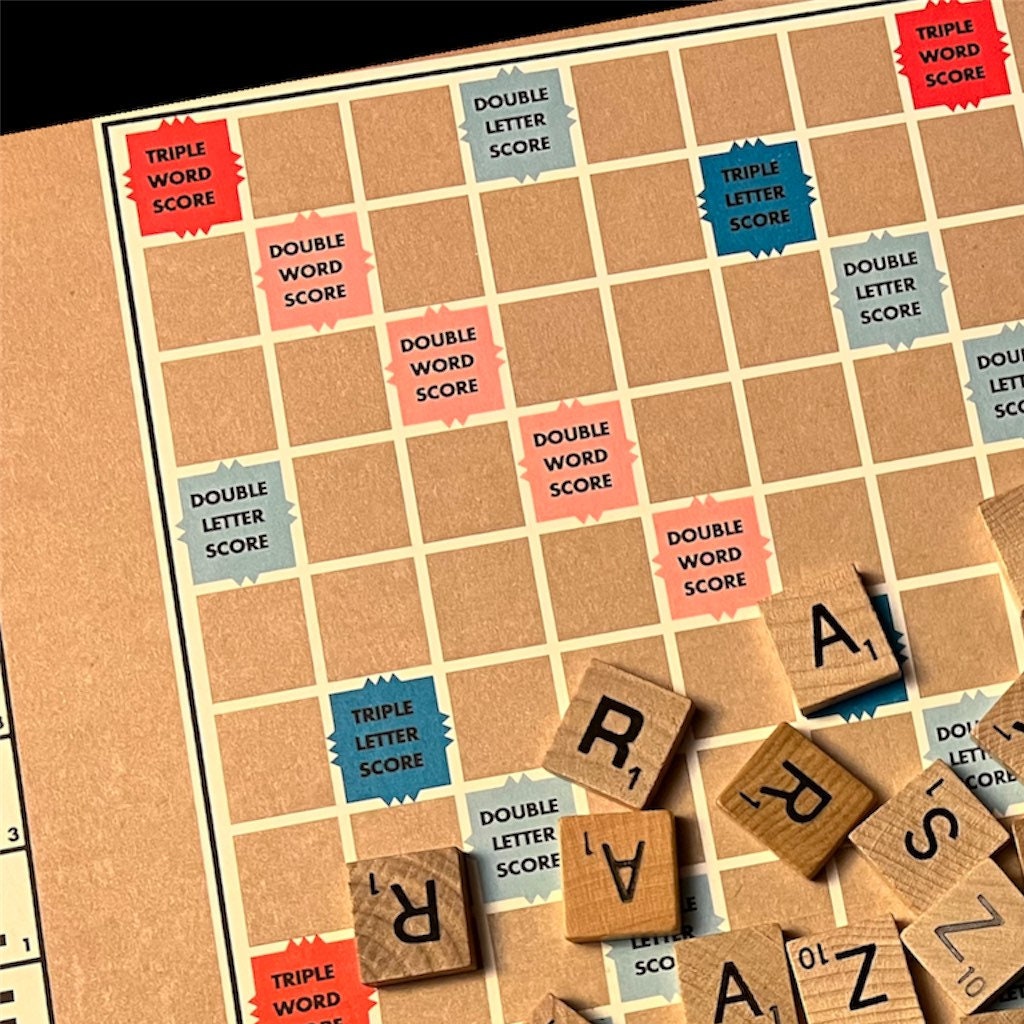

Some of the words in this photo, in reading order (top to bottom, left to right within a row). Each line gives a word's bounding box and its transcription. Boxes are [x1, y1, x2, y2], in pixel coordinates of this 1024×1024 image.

[915, 19, 974, 40] TRIPLE
[919, 43, 981, 64] WORD
[925, 65, 986, 88] SCORE
[474, 87, 549, 112] DOUBLE
[485, 112, 546, 134] LETTER
[145, 141, 206, 164] TRIPLE
[489, 136, 551, 158] SCORE
[147, 166, 212, 189] WORD
[721, 161, 780, 183] TRIPLE
[152, 190, 215, 214] SCORE
[725, 185, 786, 208] LETTER
[730, 208, 790, 232] SCORE
[269, 233, 345, 259] DOUBLE
[278, 259, 343, 282] WORD
[843, 251, 918, 277] DOUBLE
[284, 284, 347, 307] SCORE
[855, 277, 916, 301] LETTER
[860, 301, 922, 325] SCORE
[533, 421, 610, 448] DOUBLE
[543, 448, 608, 472] WORD
[190, 481, 268, 508] DOUBLE
[549, 473, 613, 498] SCORE
[202, 509, 265, 533] LETTER
[667, 519, 744, 546] DOUBLE
[205, 534, 269, 559] SCORE
[677, 546, 742, 570] WORD
[684, 572, 747, 597] SCORE
[351, 699, 414, 724] TRIPLE
[355, 726, 420, 751] LETTER
[359, 752, 424, 778] SCORE
[478, 797, 560, 826] DOUBLE
[491, 825, 558, 851] LETTER
[495, 852, 561, 878] SCORE
[270, 964, 335, 989] TRIPLE
[272, 991, 341, 1017] WORD
